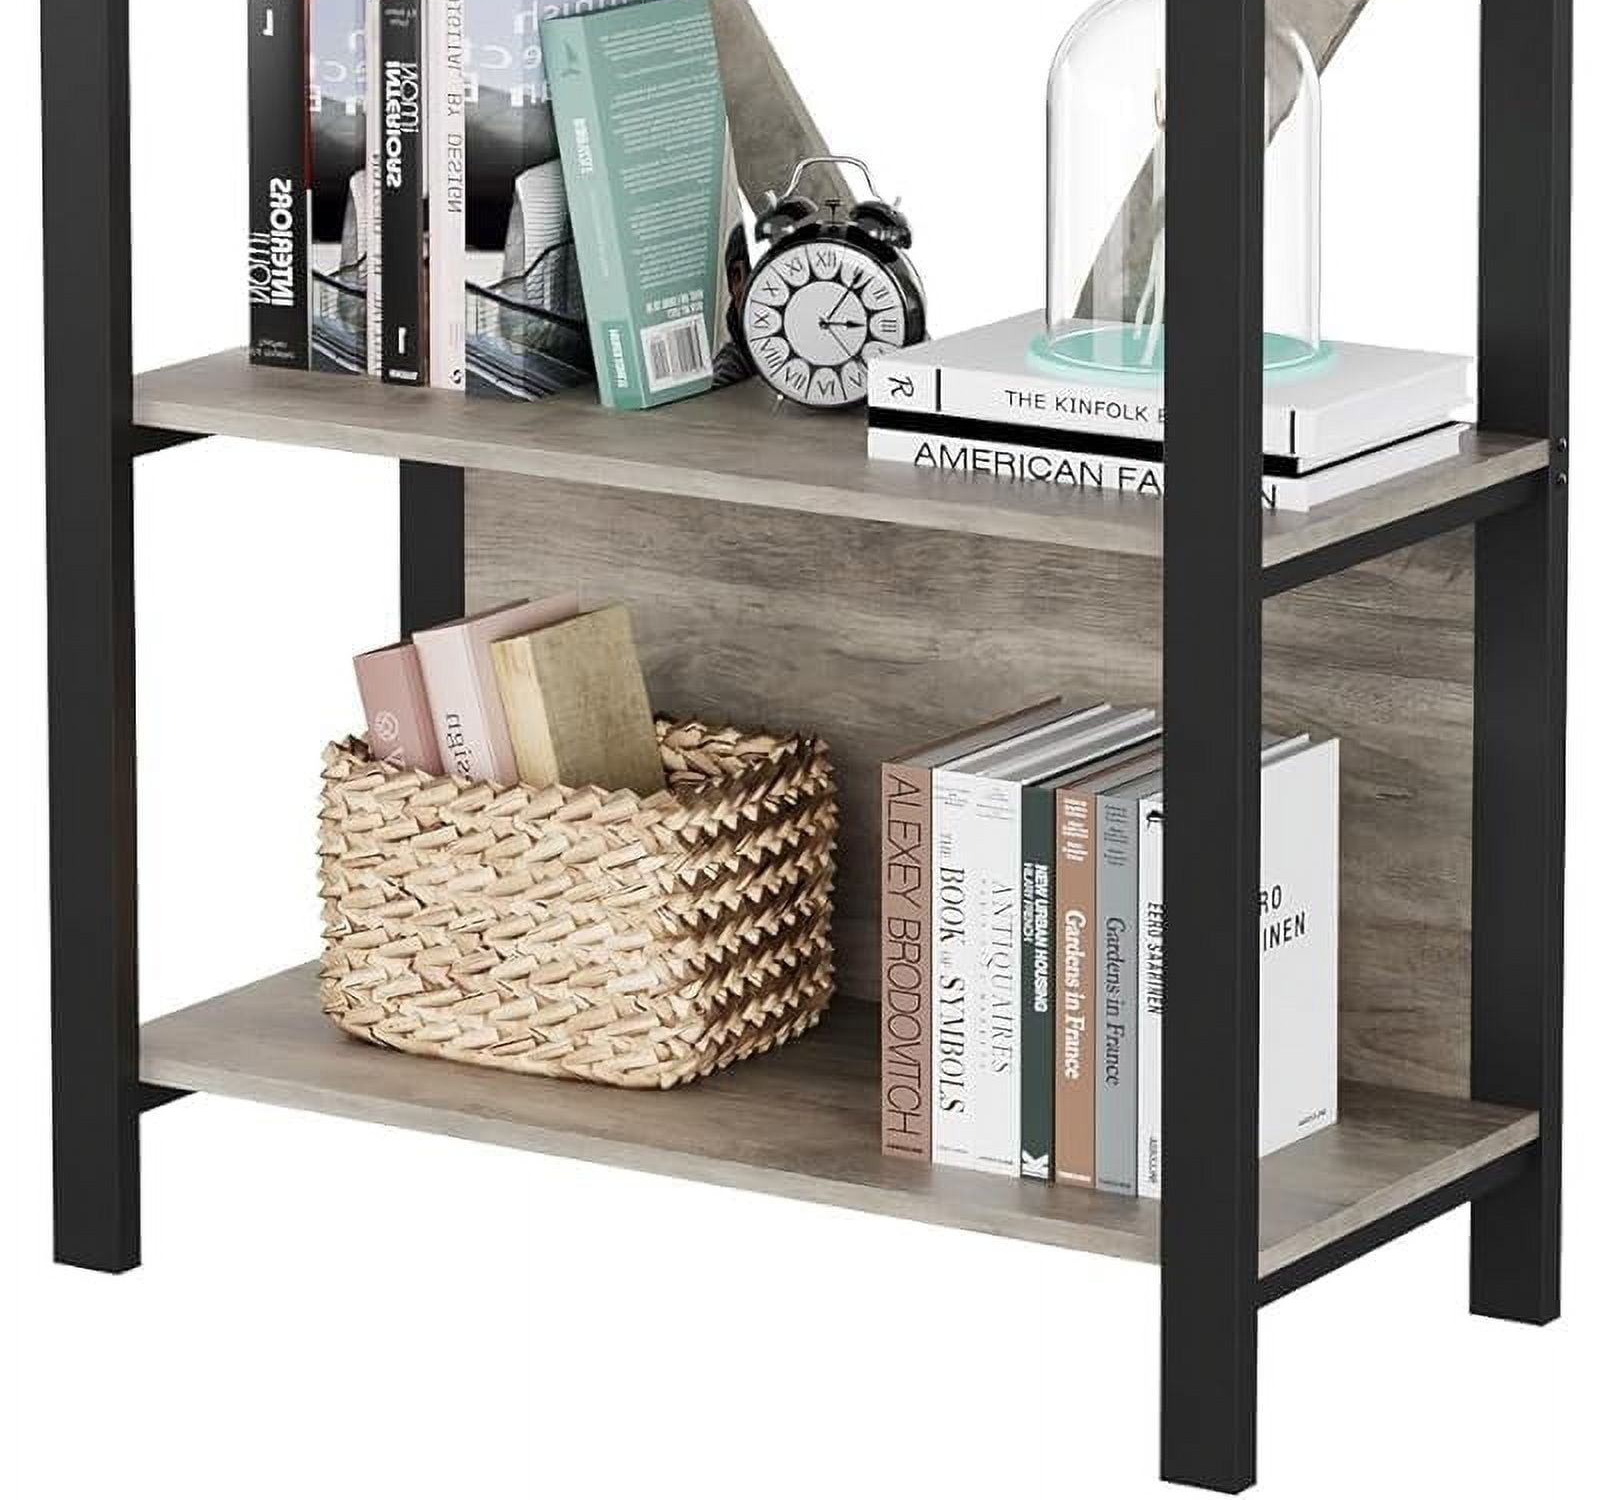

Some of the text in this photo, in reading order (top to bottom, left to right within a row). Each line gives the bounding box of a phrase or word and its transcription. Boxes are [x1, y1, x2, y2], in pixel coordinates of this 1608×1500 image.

[784, 257, 803, 276] XI
[816, 251, 837, 269] XII
[762, 280, 780, 297] X
[872, 286, 890, 301] II
[753, 311, 770, 329] IX
[878, 318, 897, 333] III
[760, 338, 785, 378] VIII
[785, 366, 808, 390] VII
[817, 380, 835, 397] VI
[1004, 389, 1047, 412] THE
[1056, 396, 1149, 423] KINFOLK
[913, 441, 1102, 486] AMERICAN
[887, 773, 922, 909] ALEXEY
[938, 866, 966, 946] BOOK
[1259, 884, 1283, 917] RO
[1033, 864, 1048, 1013] NEW URBAN HOUSING
[981, 880, 1014, 1077] ANTIQUAIRES
[1147, 902, 1163, 1016] EERO SAARINEN
[1063, 910, 1087, 1080] Gardens in France
[1104, 916, 1126, 1088] Gardens in France
[887, 918, 922, 1140] BRODOVITCH
[938, 974, 966, 1114] SYMBOLS
